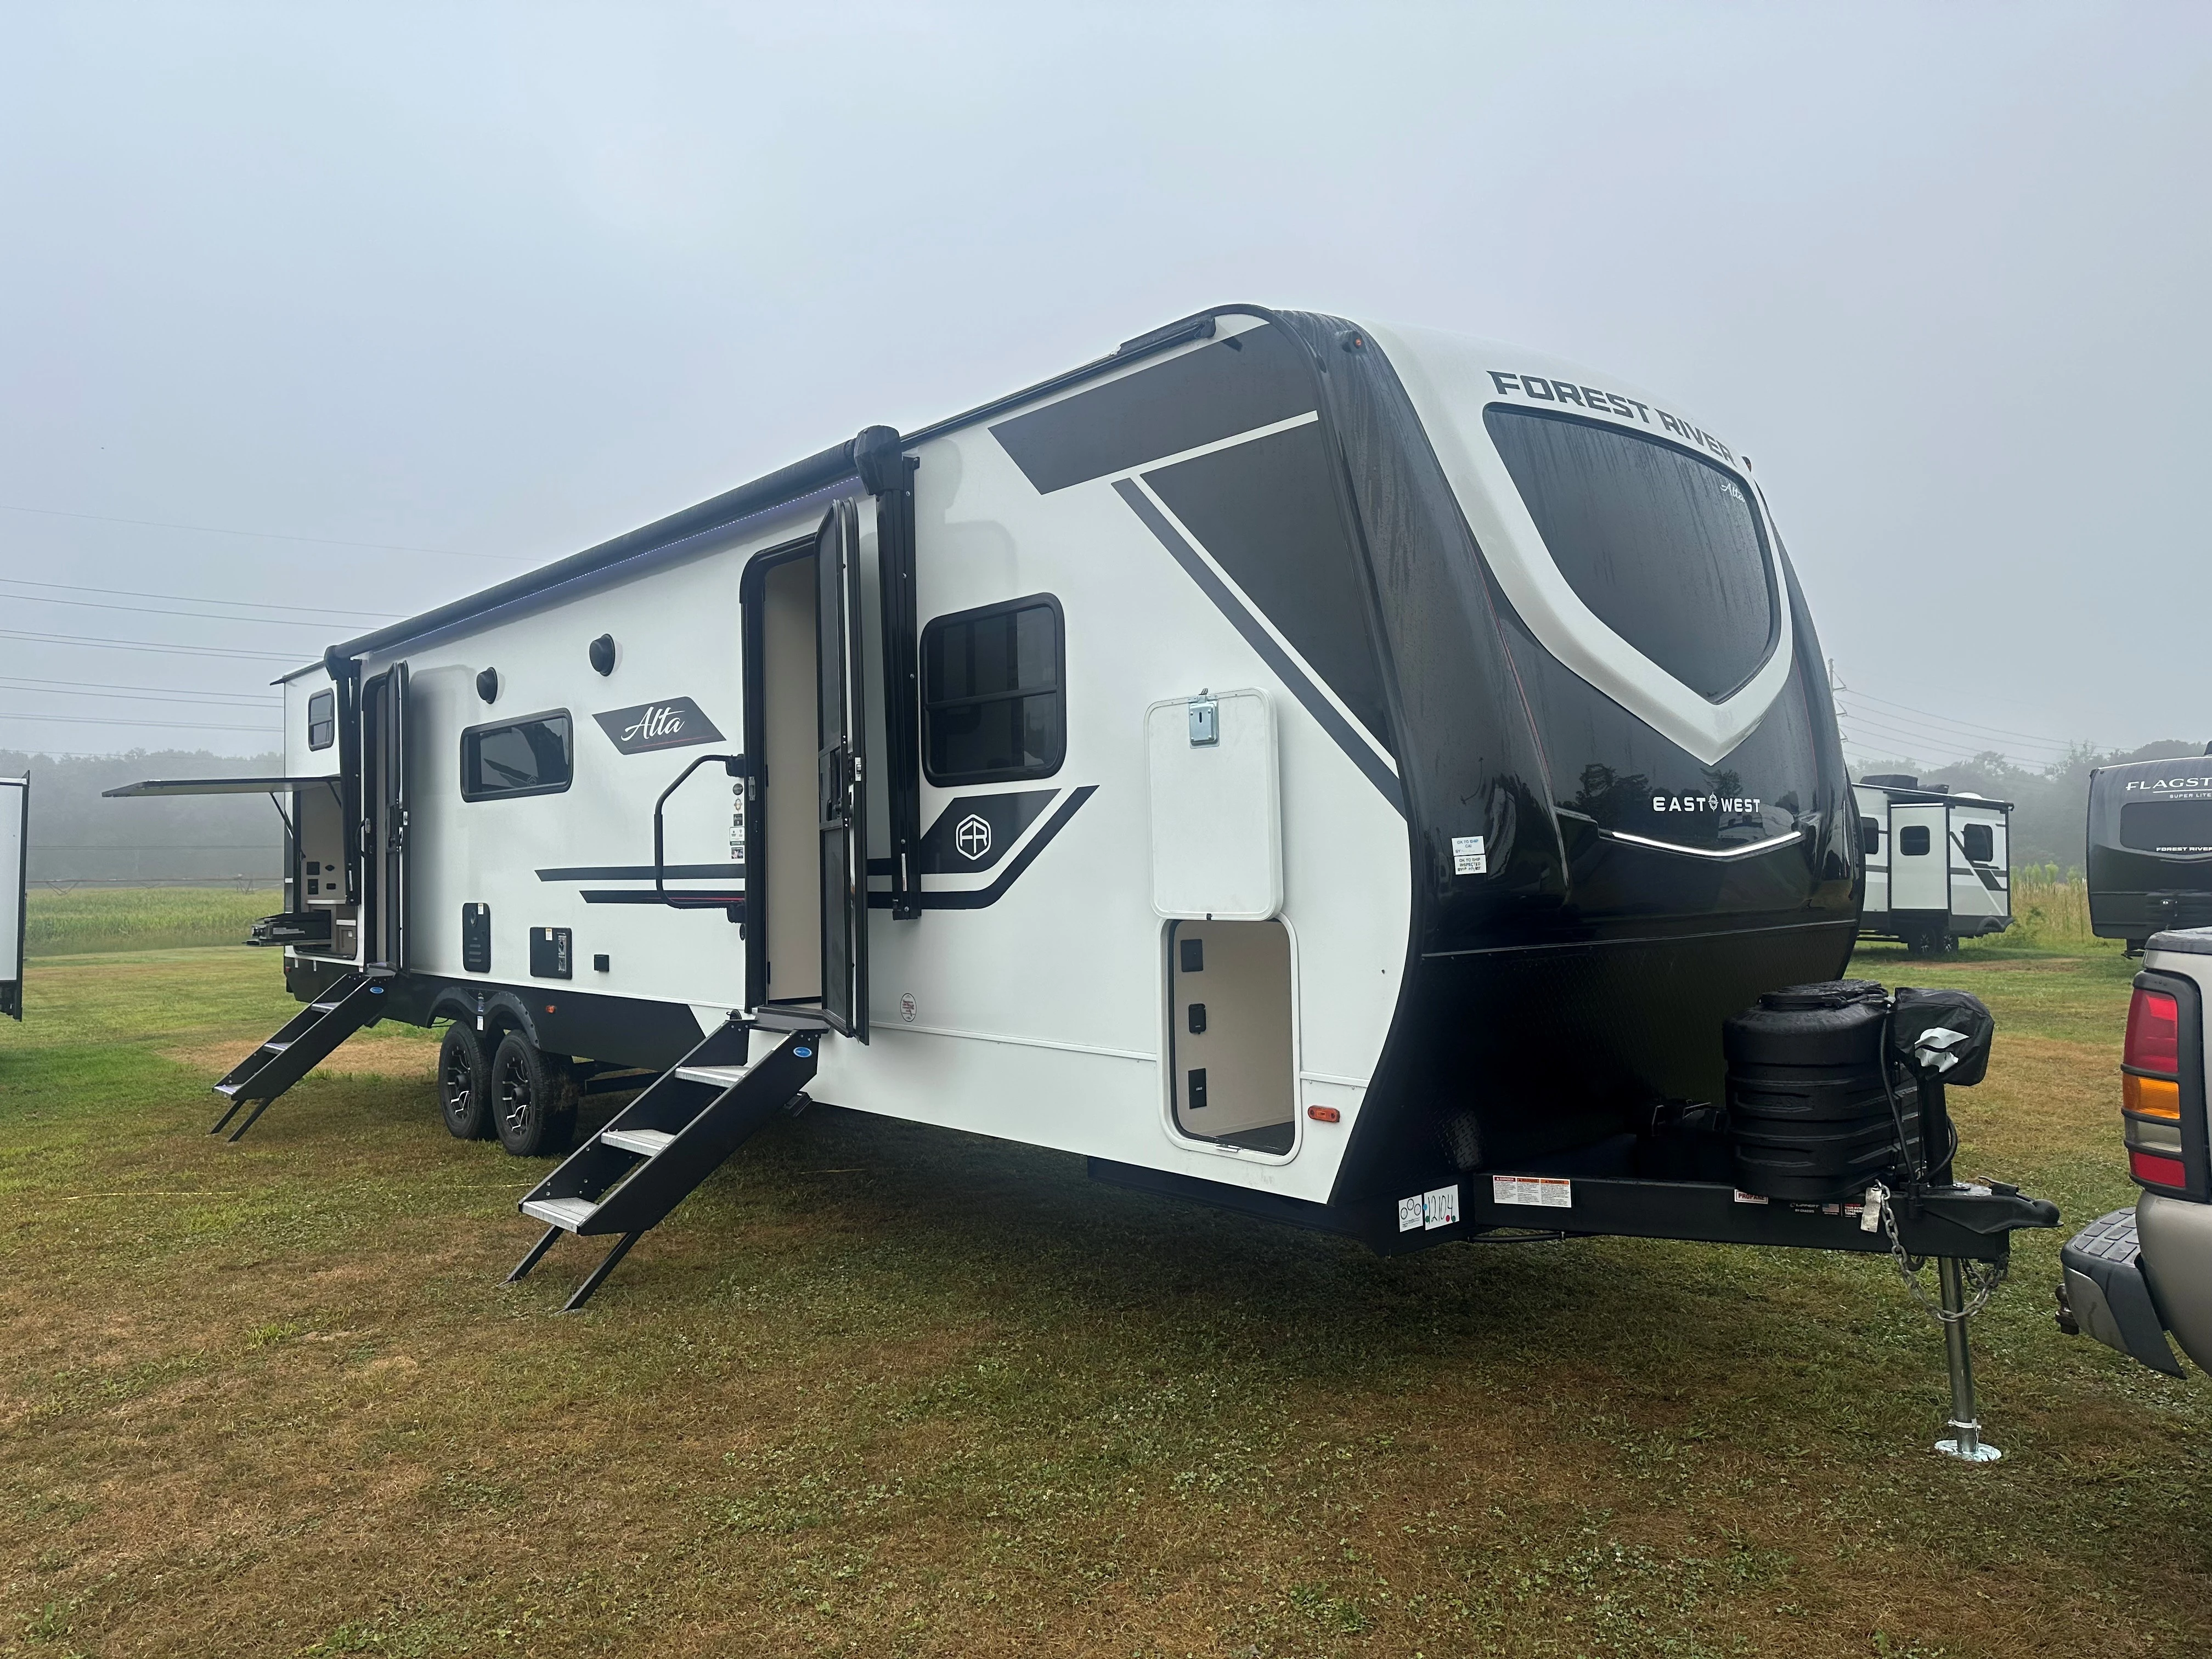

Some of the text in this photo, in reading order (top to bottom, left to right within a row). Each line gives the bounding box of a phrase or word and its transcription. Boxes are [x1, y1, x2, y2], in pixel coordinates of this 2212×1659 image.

[1486, 370, 1736, 467] FOREST RIVER
[1720, 482, 1746, 503] Alta
[620, 706, 685, 742] Alta
[1652, 796, 1760, 813] EAST WEST
